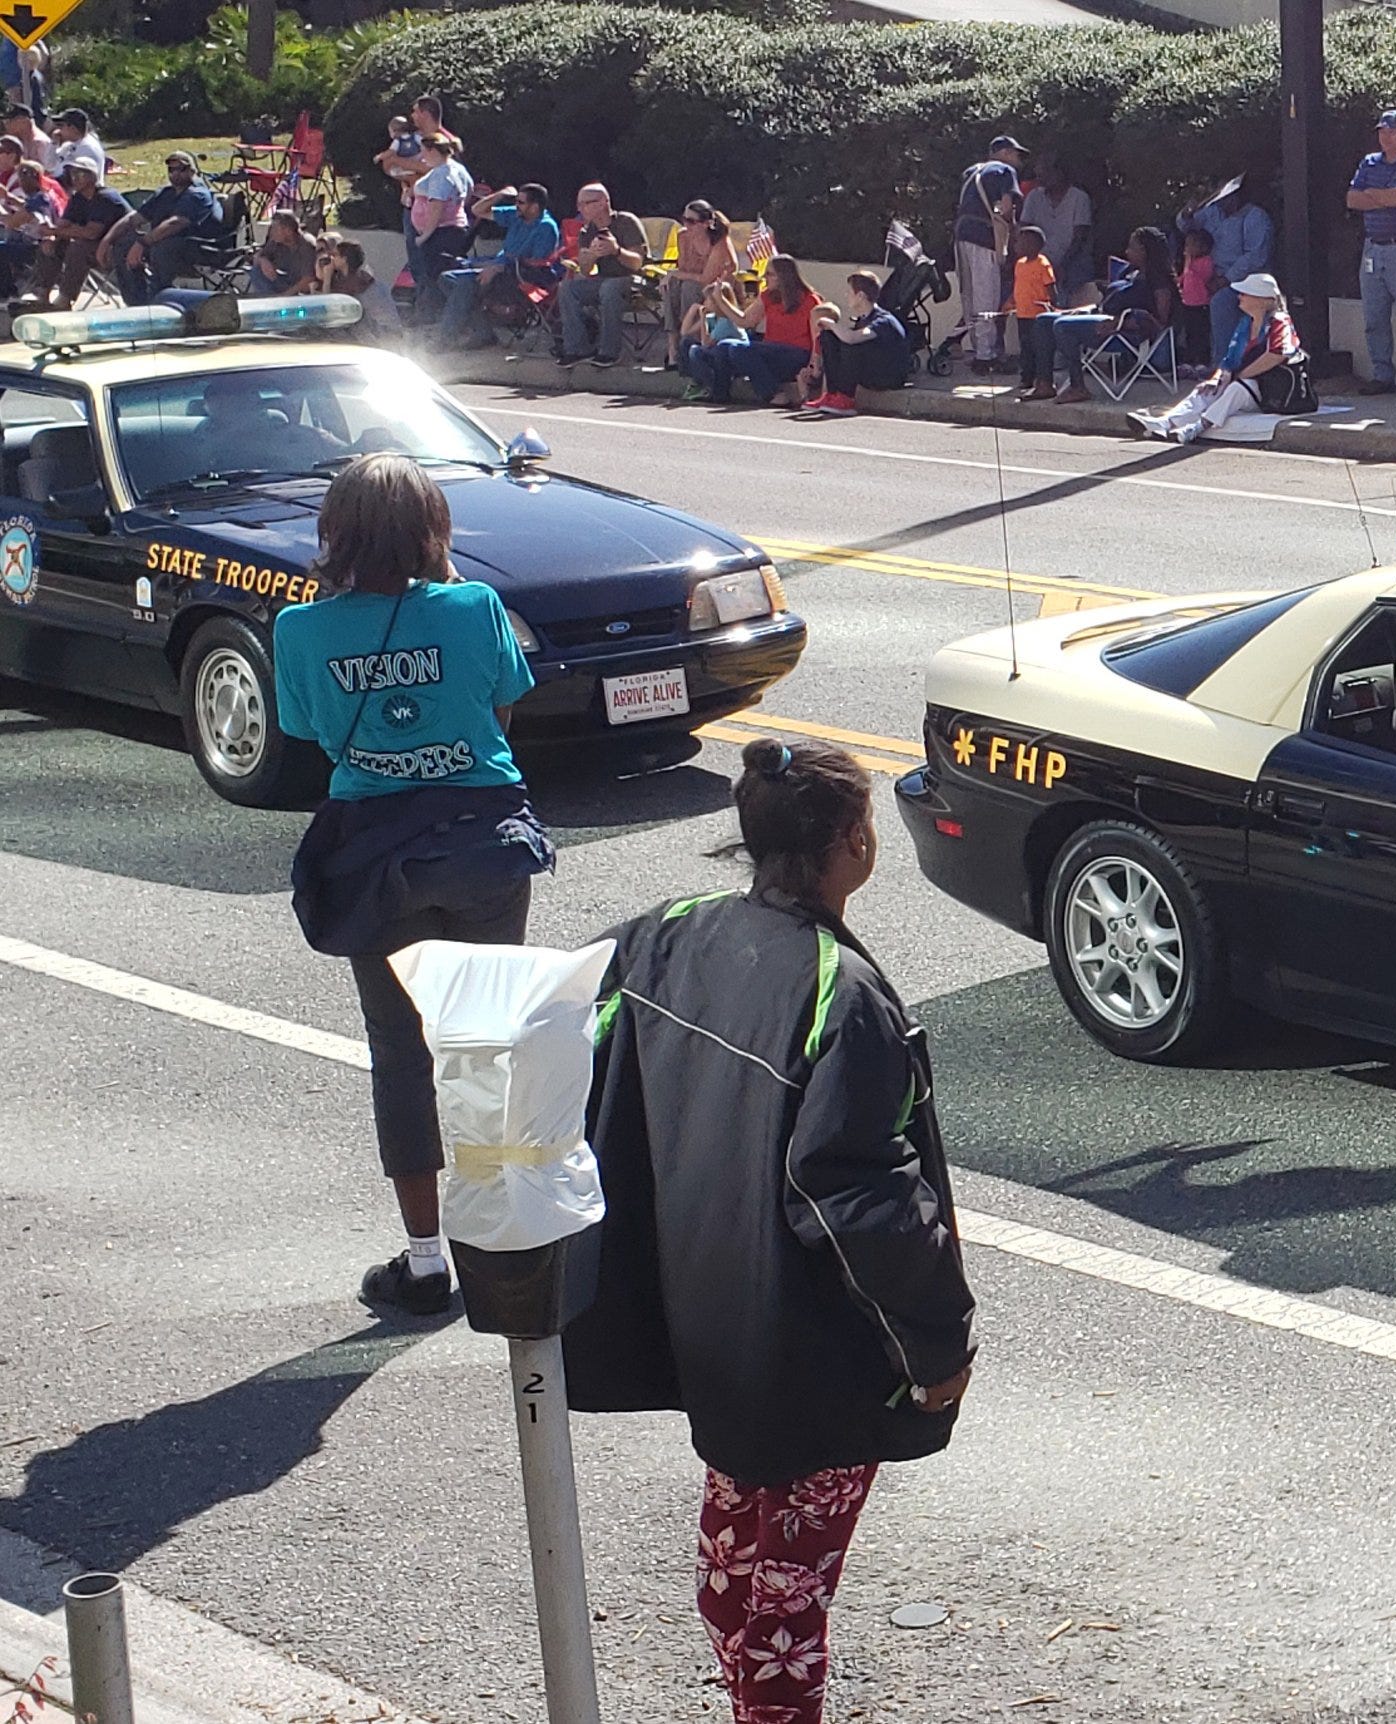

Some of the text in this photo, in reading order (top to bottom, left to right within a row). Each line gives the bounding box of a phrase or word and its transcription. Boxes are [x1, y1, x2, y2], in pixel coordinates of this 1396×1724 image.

[147, 543, 320, 604] STATE TROOPER
[328, 647, 441, 693] VISION
[623, 673, 666, 686] FLORIDA
[613, 681, 683, 708] ARRIVE ALIVE
[391, 706, 414, 720] VK
[521, 1372, 545, 1394] 2
[528, 1402, 537, 1424] 1
